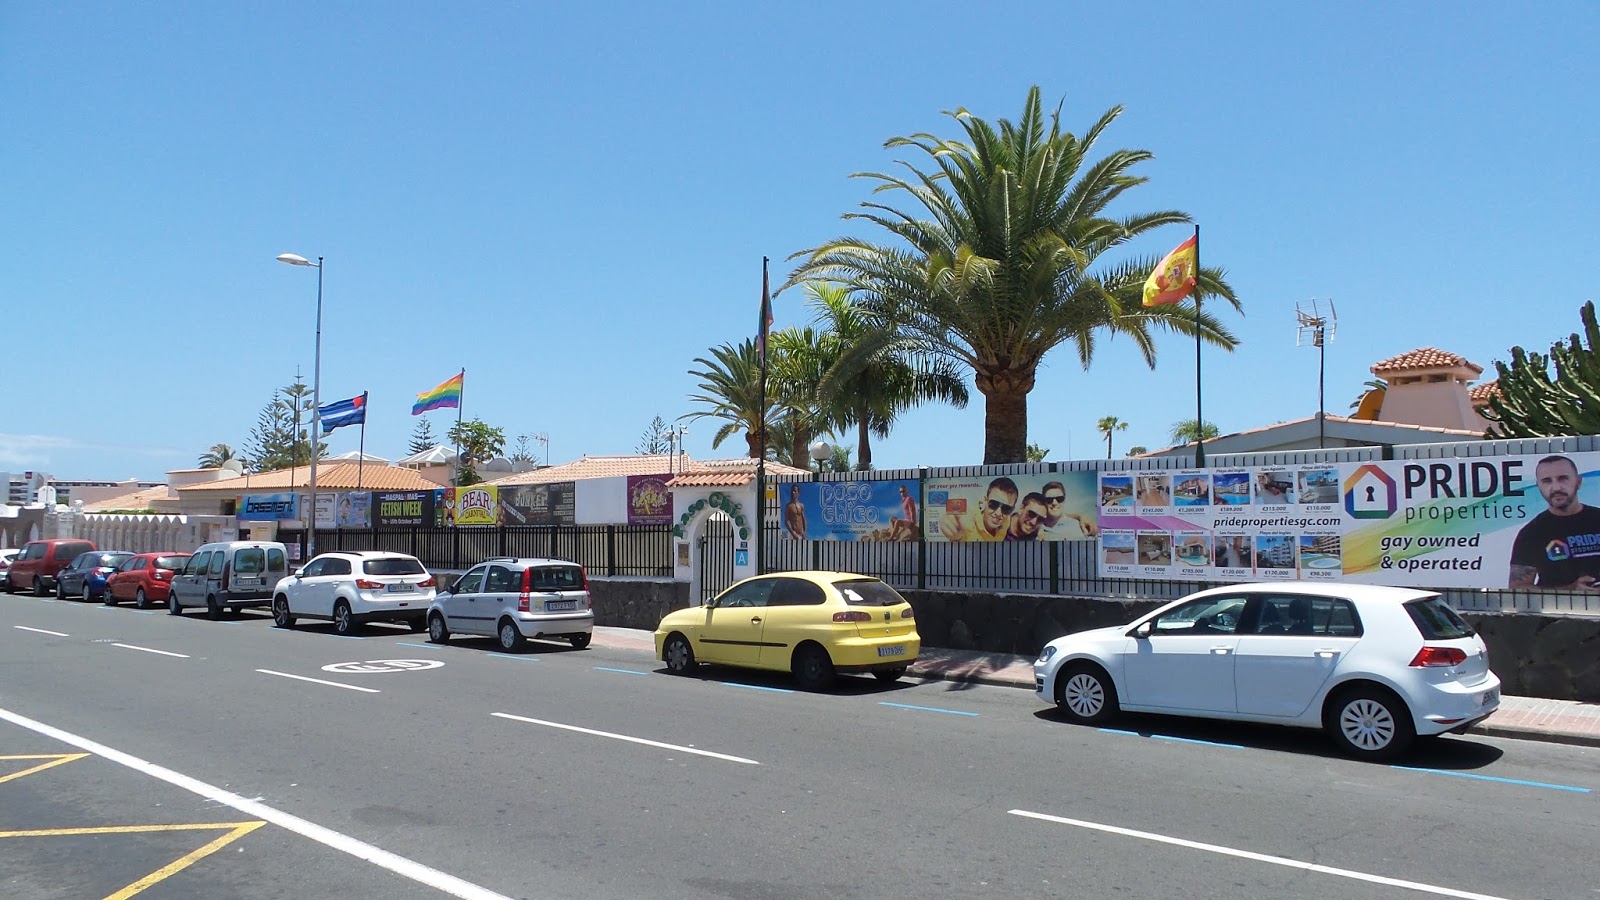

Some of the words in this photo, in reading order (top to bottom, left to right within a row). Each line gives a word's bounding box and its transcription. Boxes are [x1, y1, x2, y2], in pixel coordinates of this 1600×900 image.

[1403, 460, 1525, 499] PRIDE
[380, 502, 402, 516] FETISH
[402, 500, 422, 516] WEEK
[462, 490, 490, 511] BEAR
[1405, 502, 1526, 524] properties
[1213, 516, 1340, 528] pridepropertiesgc.com
[1381, 535, 1412, 550] gay
[1417, 533, 1480, 548] owned
[738, 552, 746, 564] A
[1381, 556, 1393, 570] &
[1398, 556, 1482, 573] operated
